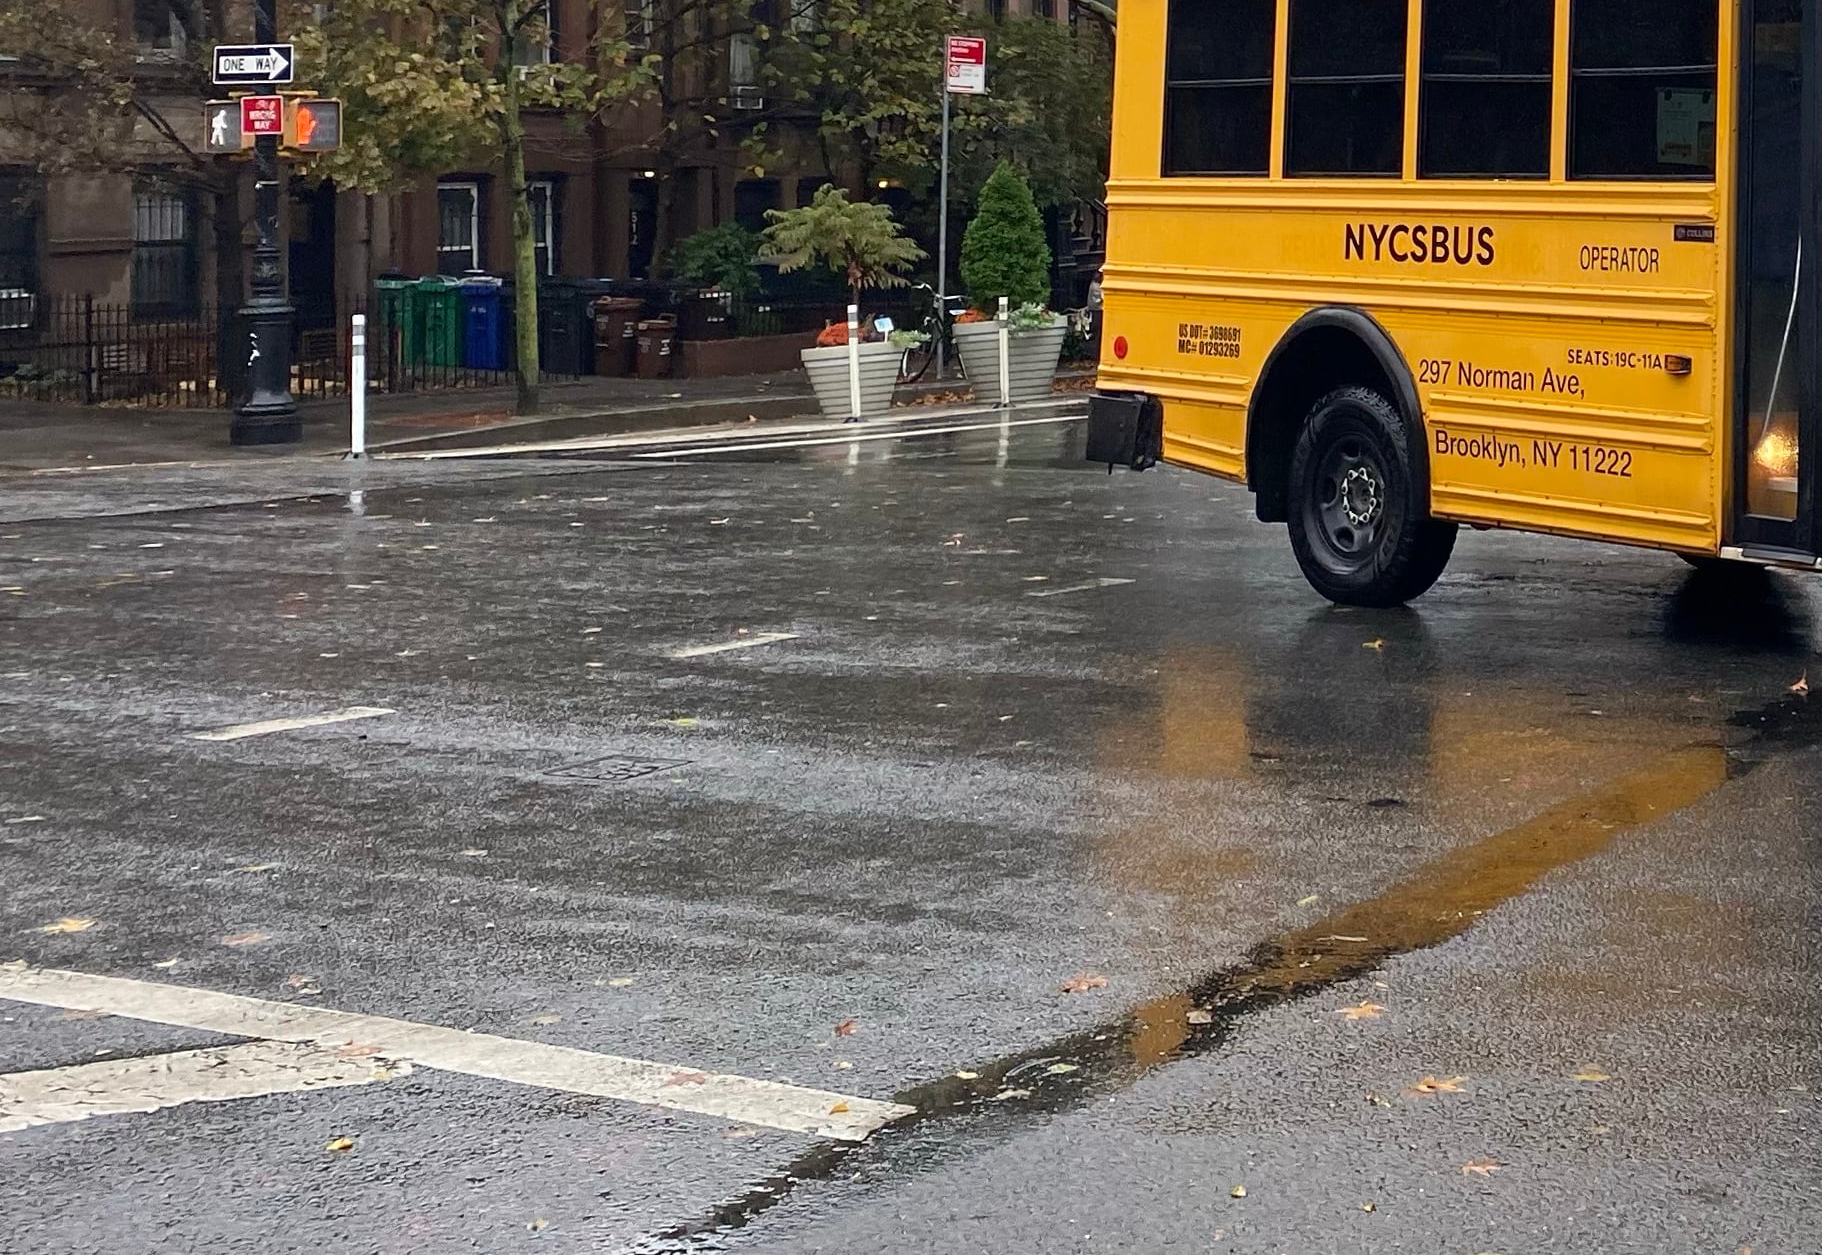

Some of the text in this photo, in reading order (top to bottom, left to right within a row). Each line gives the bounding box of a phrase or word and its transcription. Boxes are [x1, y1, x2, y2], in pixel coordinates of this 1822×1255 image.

[223, 57, 278, 72] ONE WAY
[254, 120, 271, 130] WAY
[1344, 223, 1495, 266] NYCSBUS
[1579, 245, 1660, 274] OPERATOR
[1178, 323, 1188, 338] US
[1418, 358, 1586, 400] 297 Norman Ave,
[1435, 429, 1633, 478] Brooklyn, NY 11222
